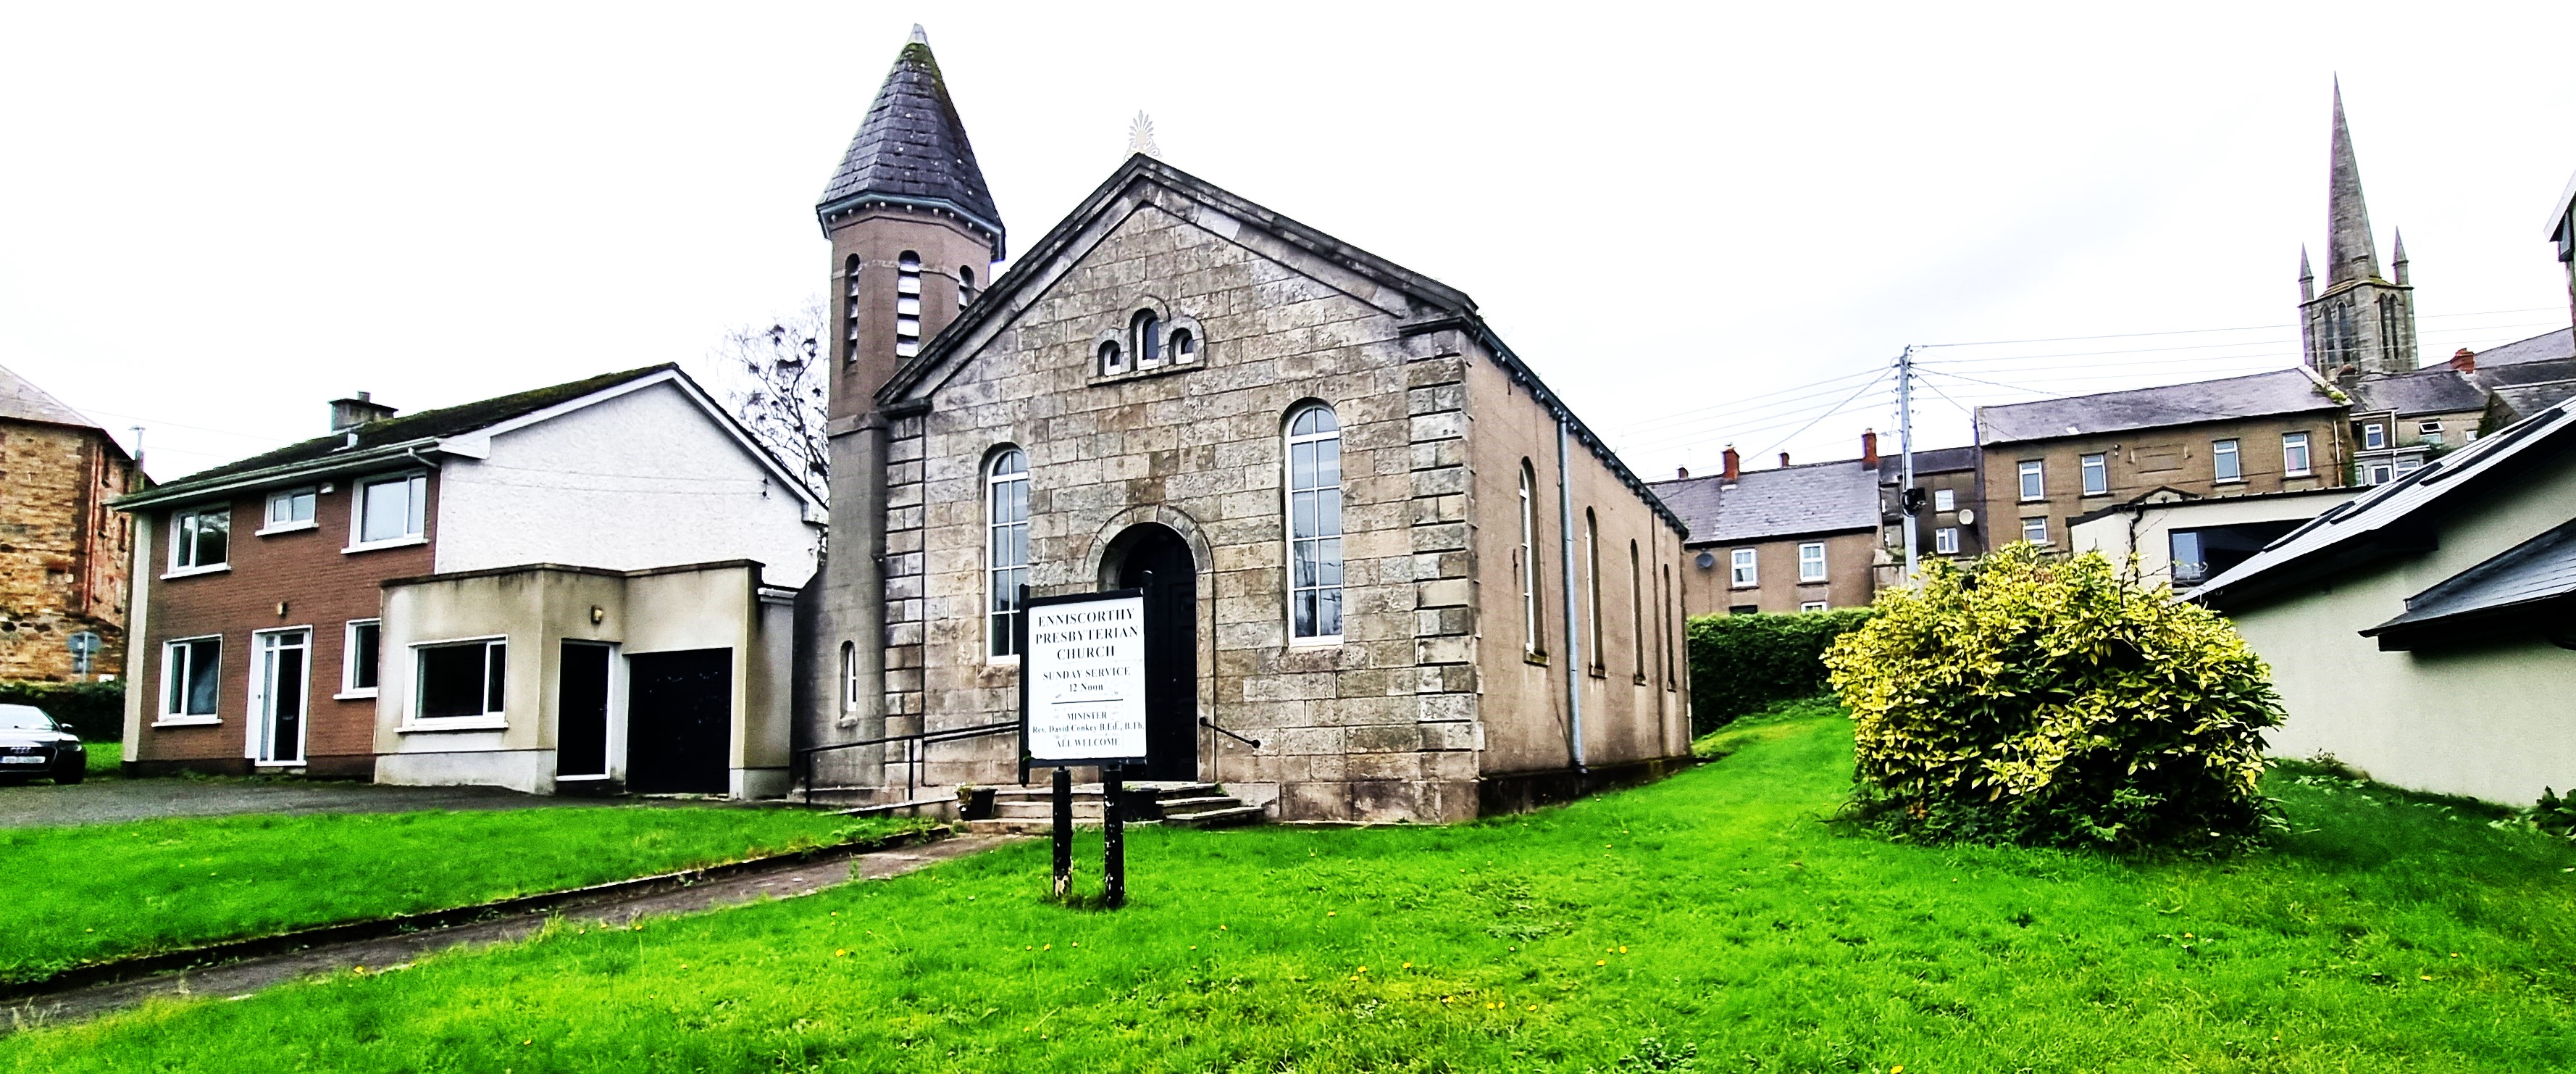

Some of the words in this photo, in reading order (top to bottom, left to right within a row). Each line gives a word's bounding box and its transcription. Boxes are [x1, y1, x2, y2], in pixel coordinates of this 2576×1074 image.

[1038, 608, 1134, 627] ENNISCORTHY
[1036, 625, 1138, 644] PRESBYTERIAN
[1057, 646, 1115, 660] CHURCH
[1043, 670, 1083, 680] SUNDAY
[1085, 666, 1131, 678] SERVICE
[1069, 683, 1077, 692] 12
[1080, 683, 1103, 692] Noon
[1067, 711, 1107, 720] MINISTER
[1056, 739, 1072, 748] ALL
[1074, 738, 1121, 747] WELCOME
